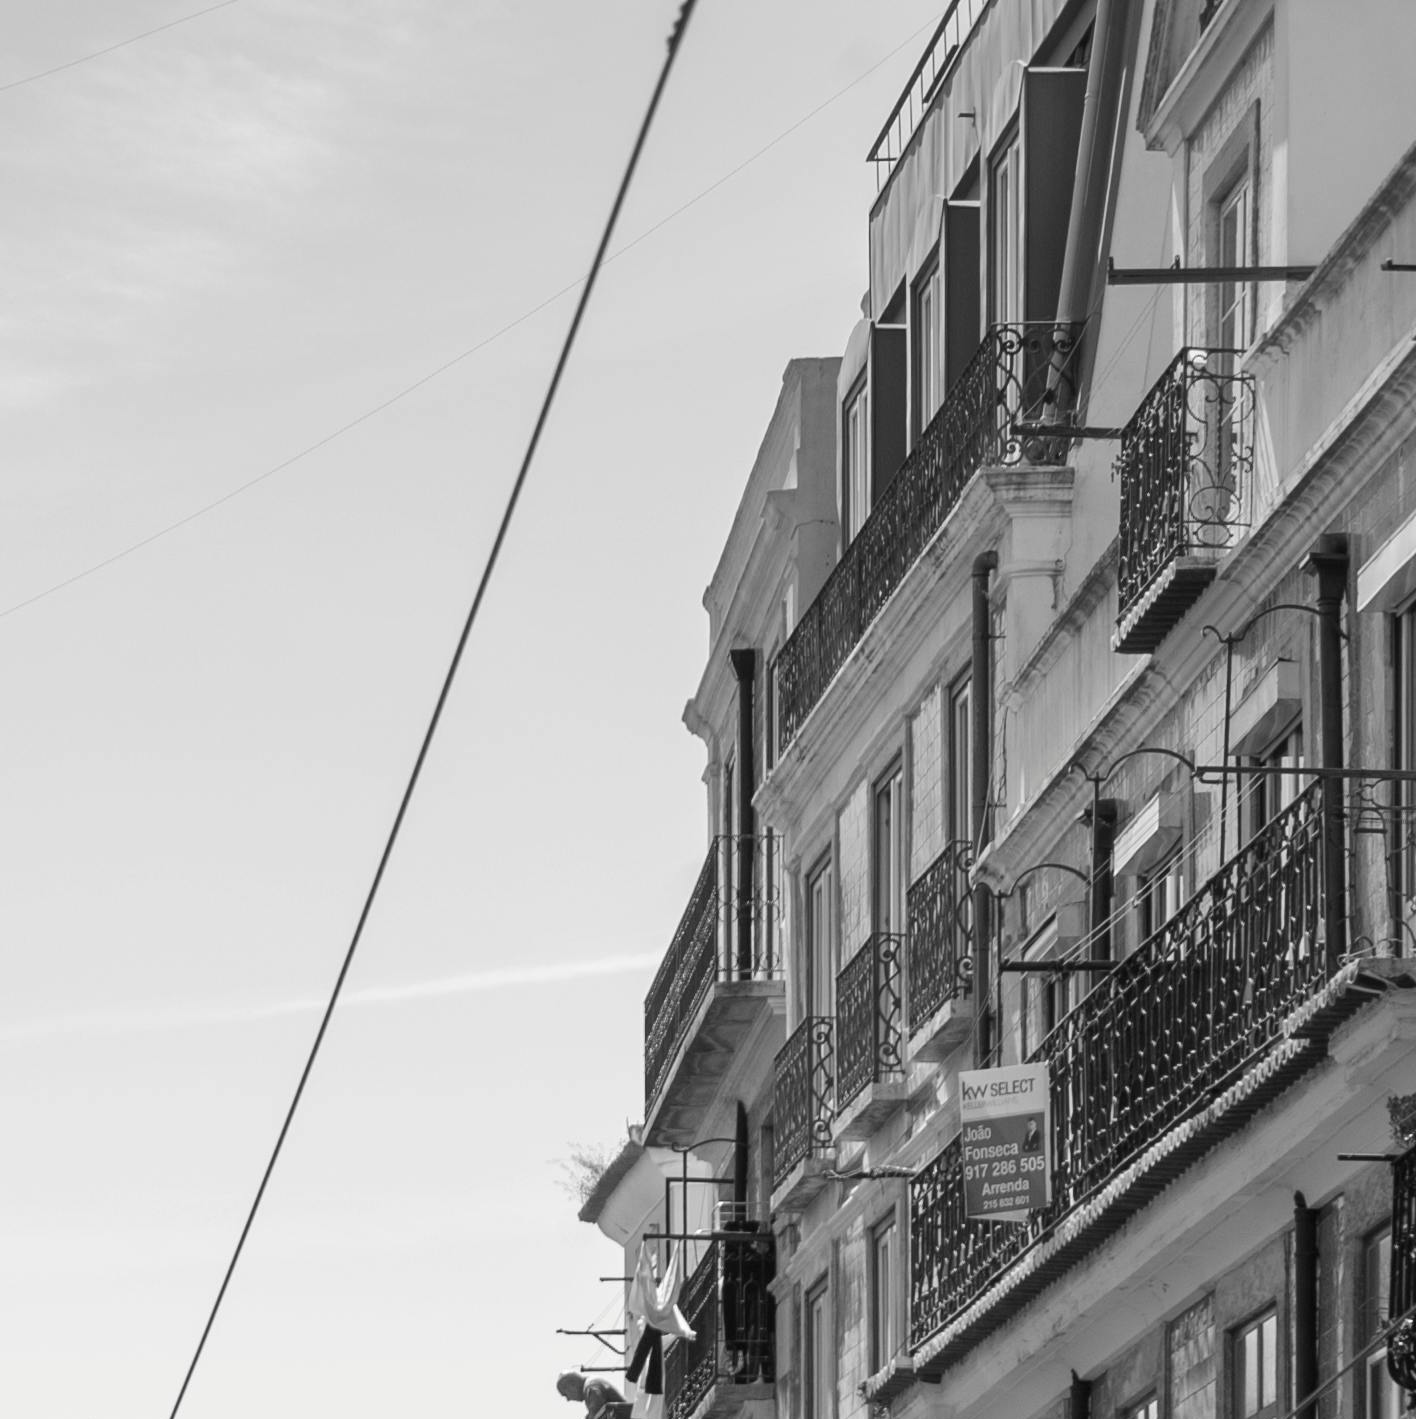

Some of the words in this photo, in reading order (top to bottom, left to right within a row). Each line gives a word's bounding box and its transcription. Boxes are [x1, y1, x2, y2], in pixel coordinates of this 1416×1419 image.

[962, 1081, 987, 1101] kw
[990, 1078, 1035, 1097] SELECT
[965, 1124, 992, 1142] João
[965, 1142, 1019, 1161] Fonseca
[965, 1163, 989, 1180] 917
[992, 1160, 1017, 1177] 286
[1020, 1155, 1045, 1173] 505
[982, 1177, 1030, 1196] Arrenda
